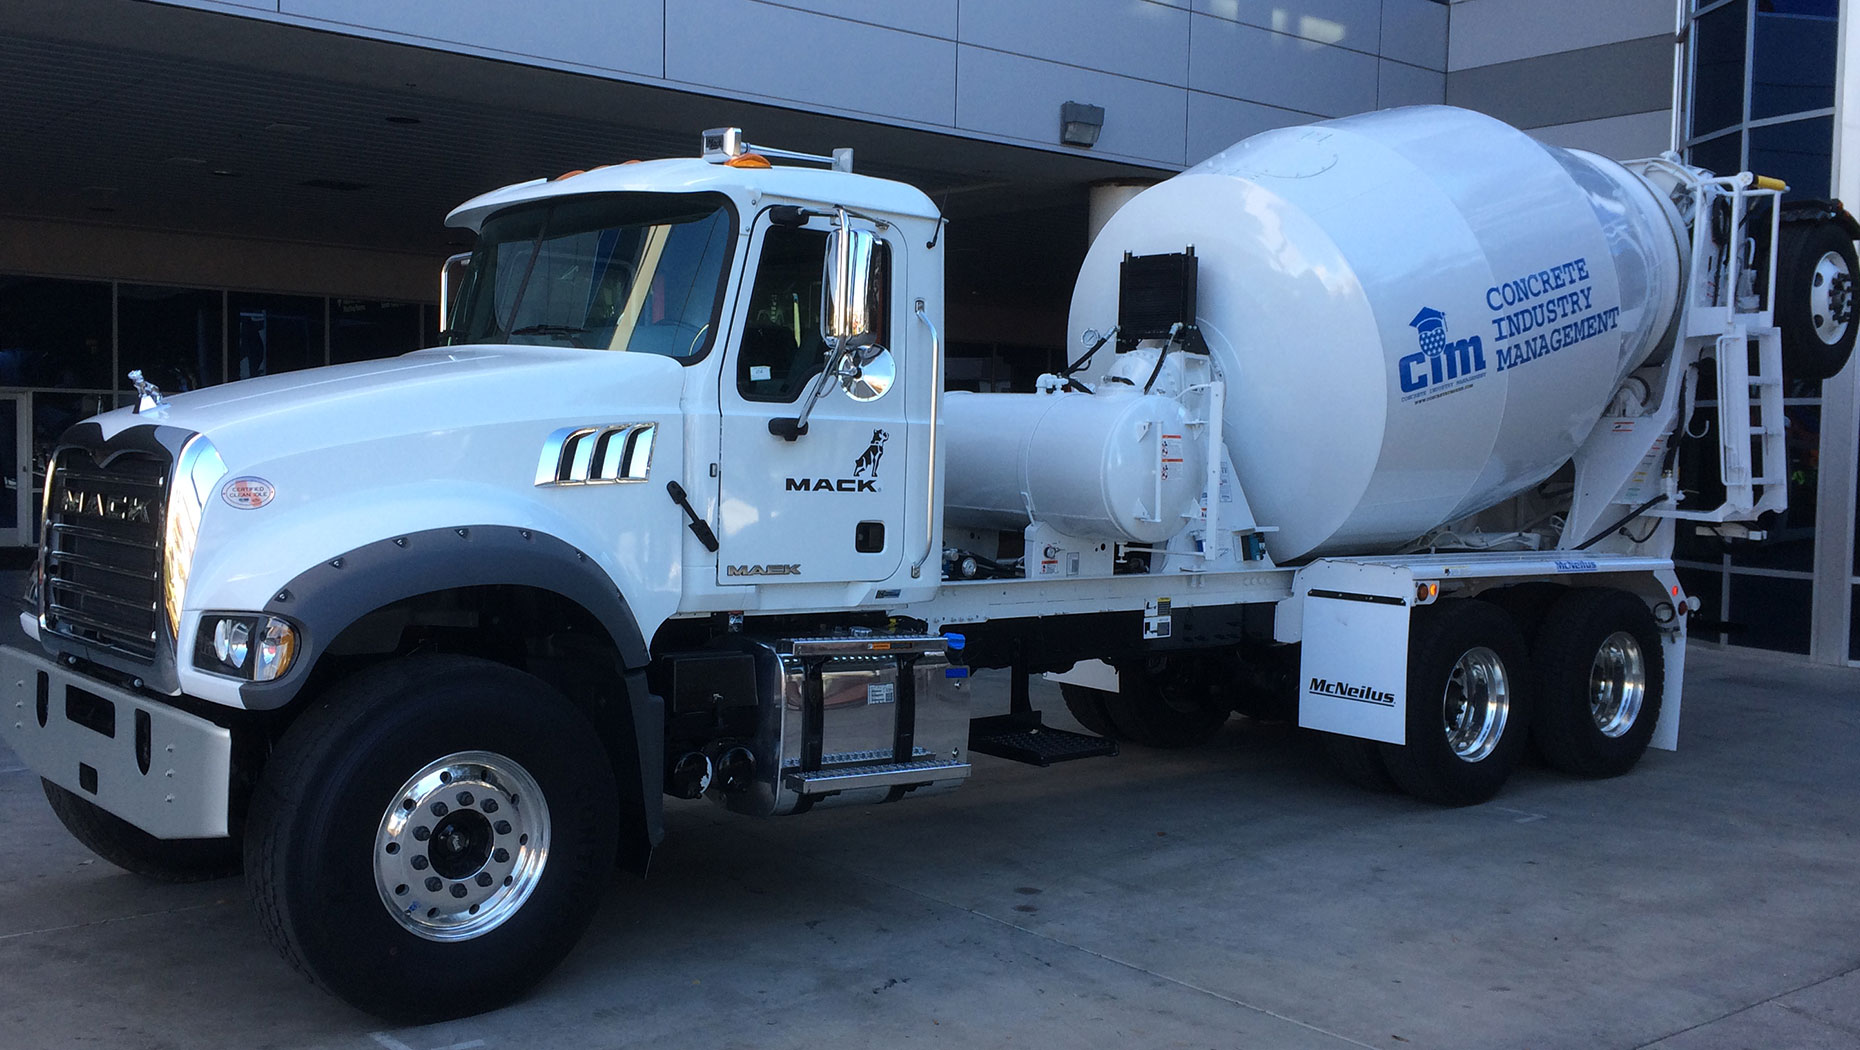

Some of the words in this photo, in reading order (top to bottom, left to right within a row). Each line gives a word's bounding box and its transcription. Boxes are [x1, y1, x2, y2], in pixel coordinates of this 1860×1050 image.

[1486, 258, 1590, 312] CONCRETE
[1491, 286, 1592, 342] INDUSTRY
[1496, 306, 1620, 372] MANAGEMENT
[786, 478, 877, 493] MACK
[61, 488, 152, 523] MACK
[727, 564, 801, 577] MACK
[1555, 560, 1597, 570] McNeilus
[1309, 677, 1395, 704] McNeilus
